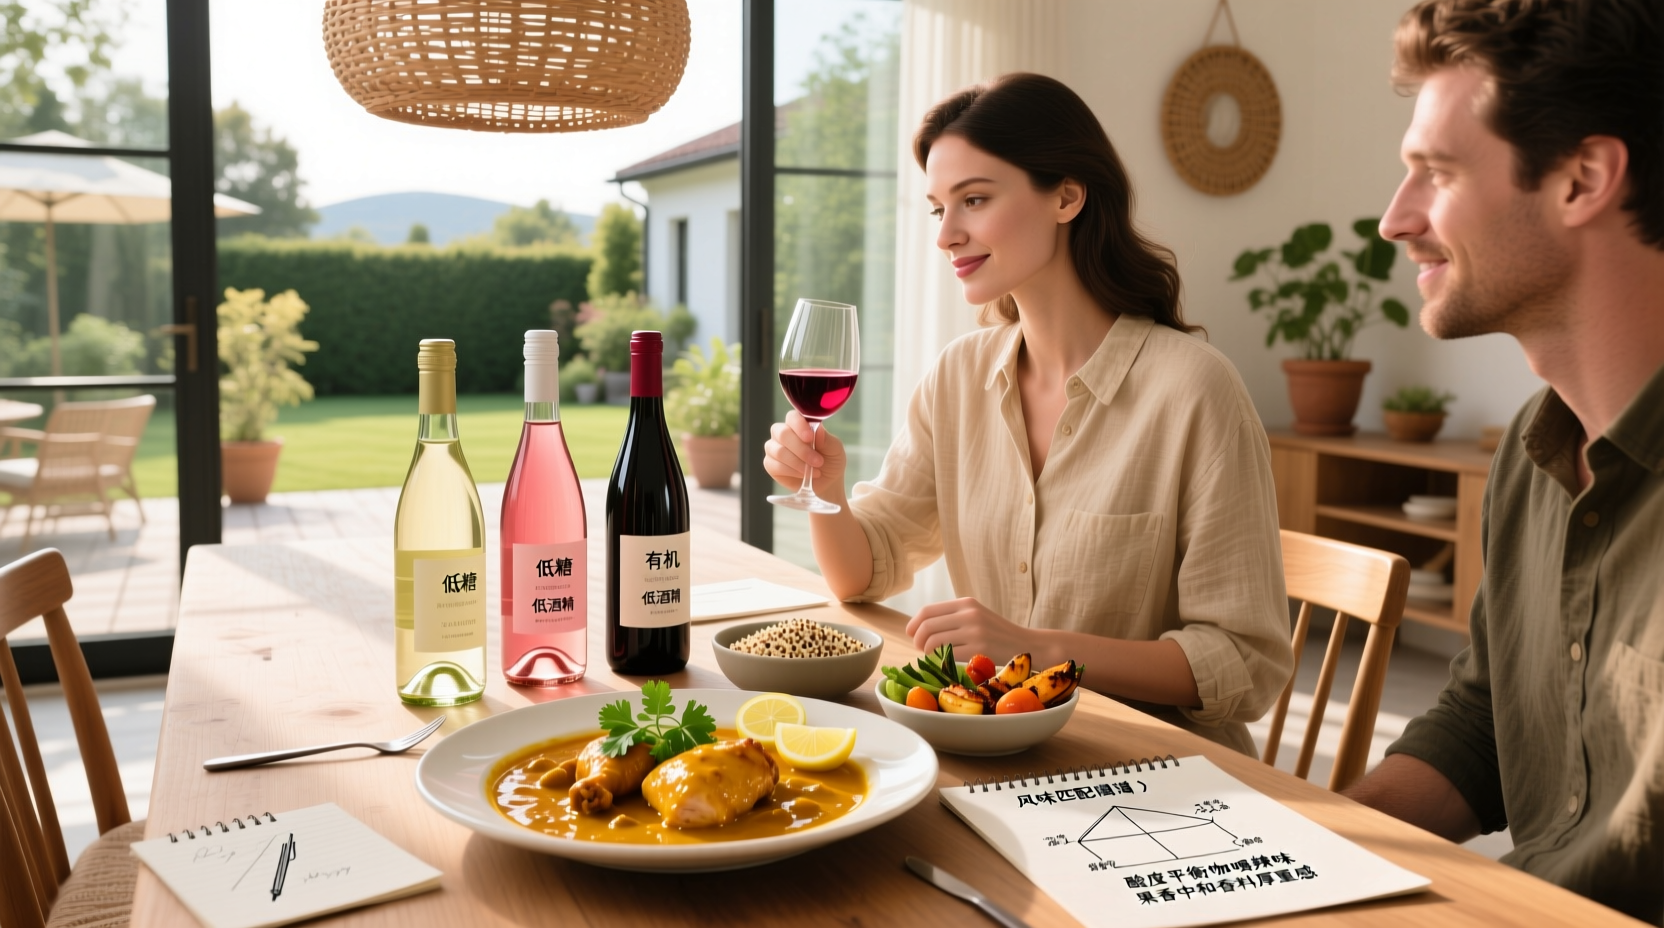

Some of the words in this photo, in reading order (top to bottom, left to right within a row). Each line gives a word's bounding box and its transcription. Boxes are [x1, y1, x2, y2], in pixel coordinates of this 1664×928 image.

[536, 557, 574, 578] 低糖
[645, 549, 681, 571] 有机
[441, 572, 478, 594] 低糖
